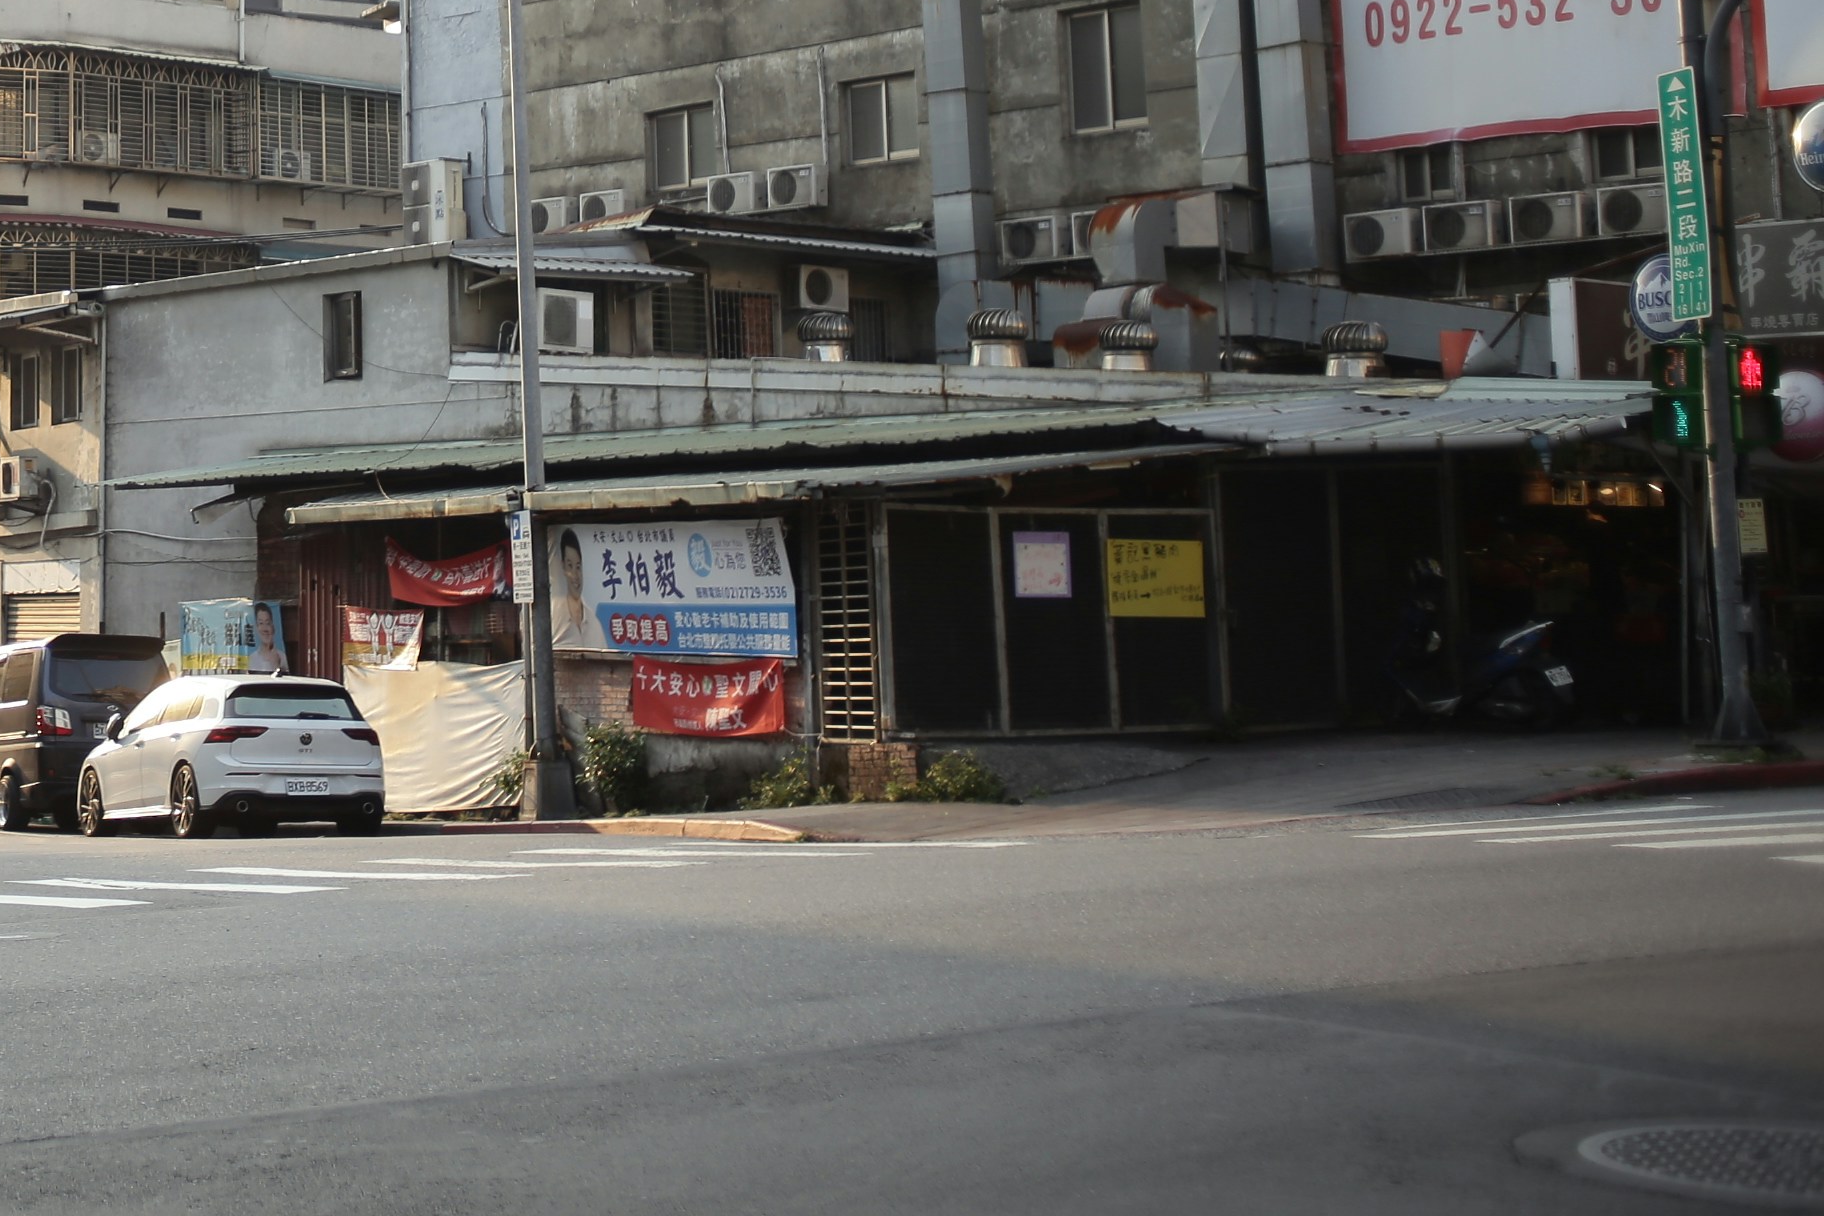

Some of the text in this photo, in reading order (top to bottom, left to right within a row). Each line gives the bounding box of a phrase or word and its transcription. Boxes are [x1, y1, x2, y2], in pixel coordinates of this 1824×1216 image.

[1668, 95, 1698, 241] 木新路二段
[1674, 242, 1705, 256] MuXin
[1675, 257, 1691, 268] Rd.
[1638, 291, 1672, 310] BUSC
[602, 548, 685, 600] 李柏毅
[611, 618, 669, 641] 爭取提高
